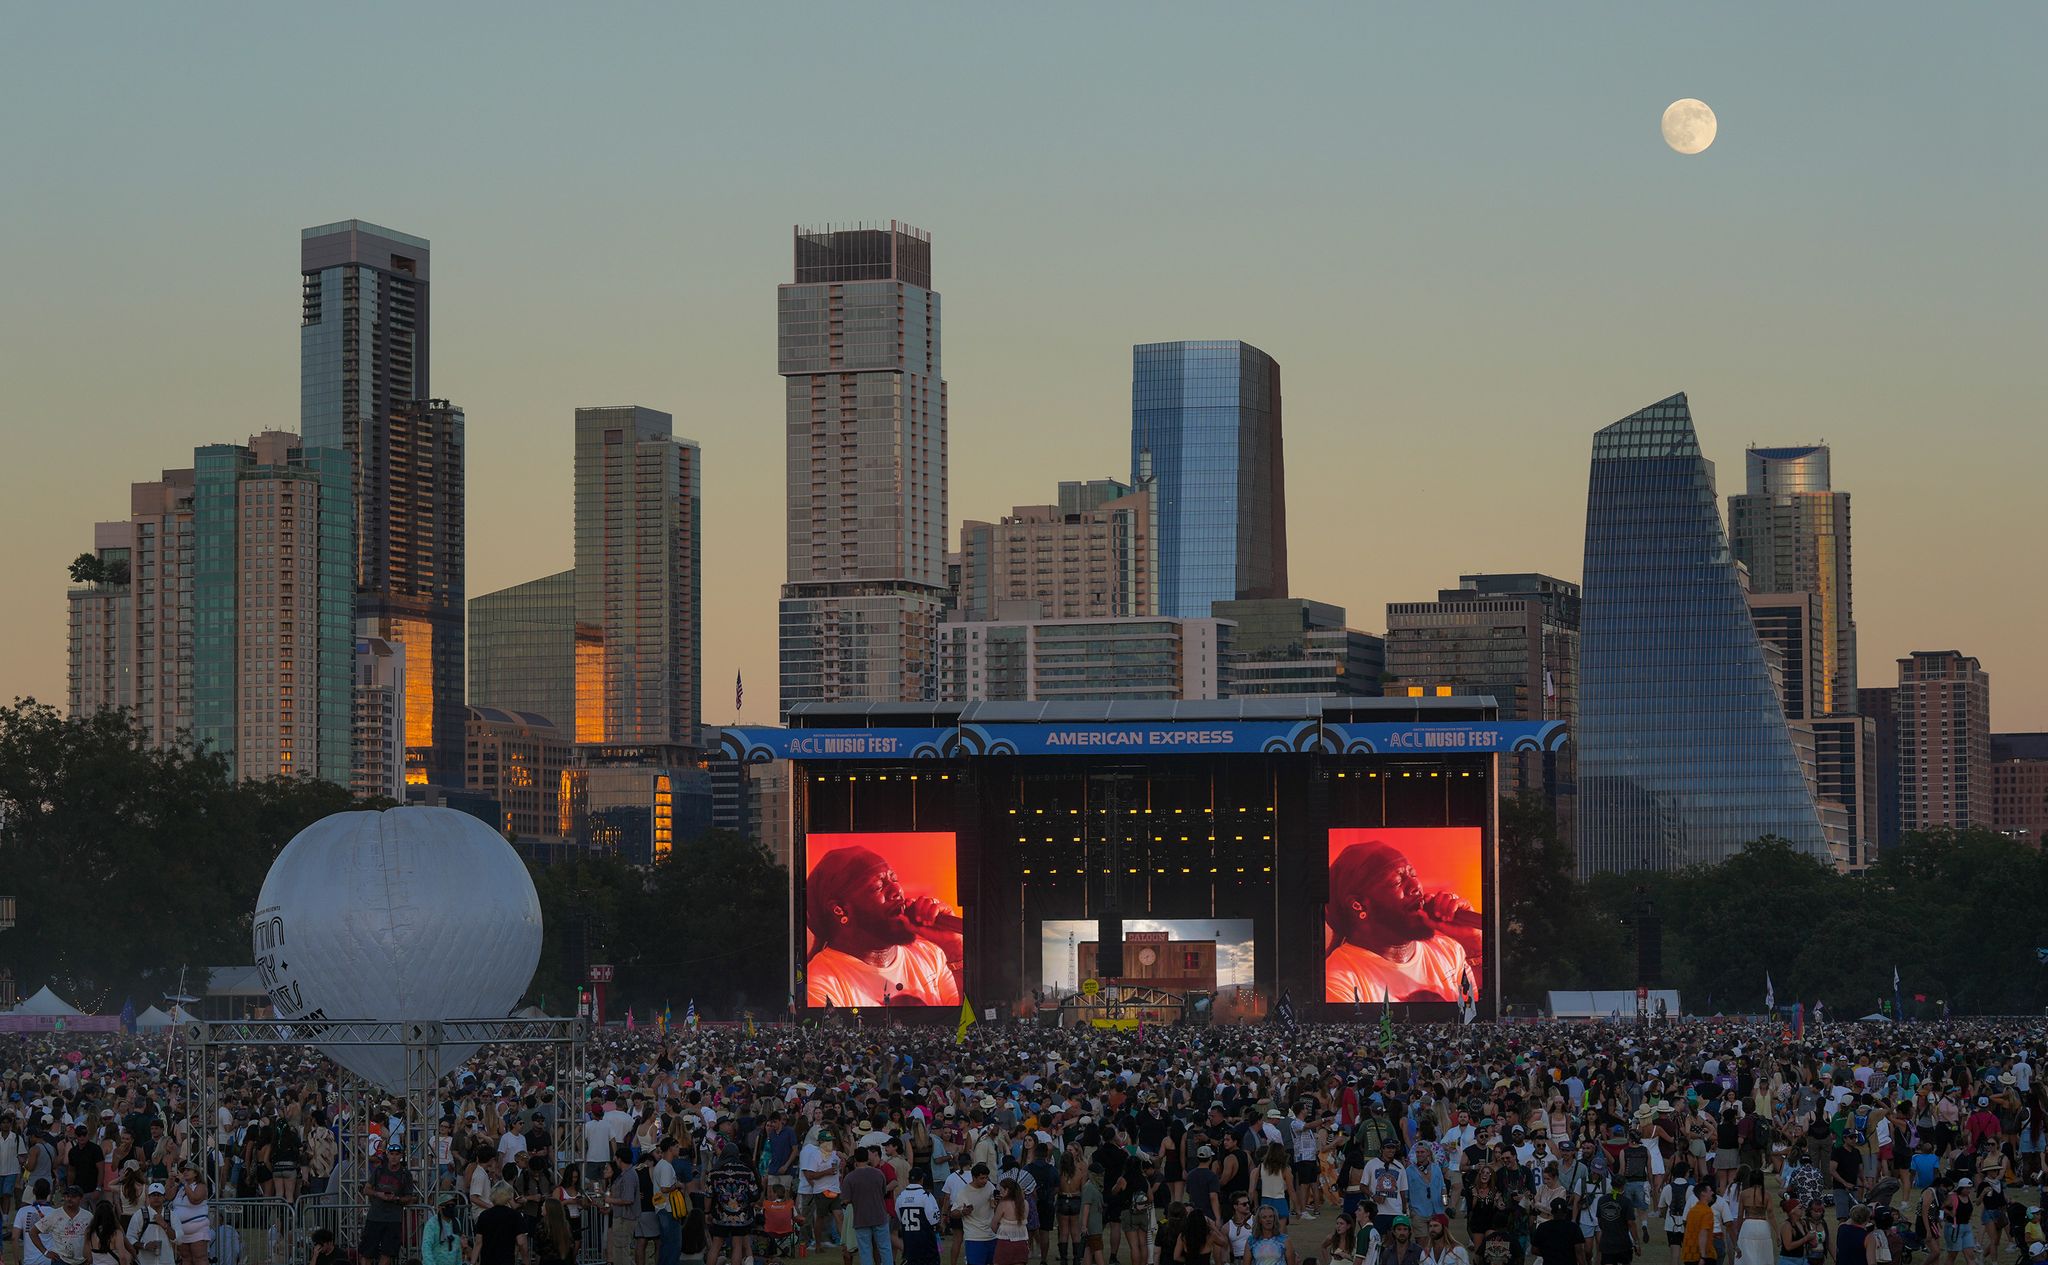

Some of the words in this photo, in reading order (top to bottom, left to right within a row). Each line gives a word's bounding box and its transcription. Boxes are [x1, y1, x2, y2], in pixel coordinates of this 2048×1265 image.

[790, 738, 823, 754] ACL
[825, 737, 865, 753] MUSIC
[868, 737, 898, 753] FEST
[1046, 731, 1143, 746] AMERICAN
[1149, 730, 1234, 745] EXPRESS
[1390, 732, 1423, 748] ACL
[1425, 731, 1465, 747] MUSIC
[1468, 731, 1498, 747] FEST
[901, 1209, 921, 1231] 45
